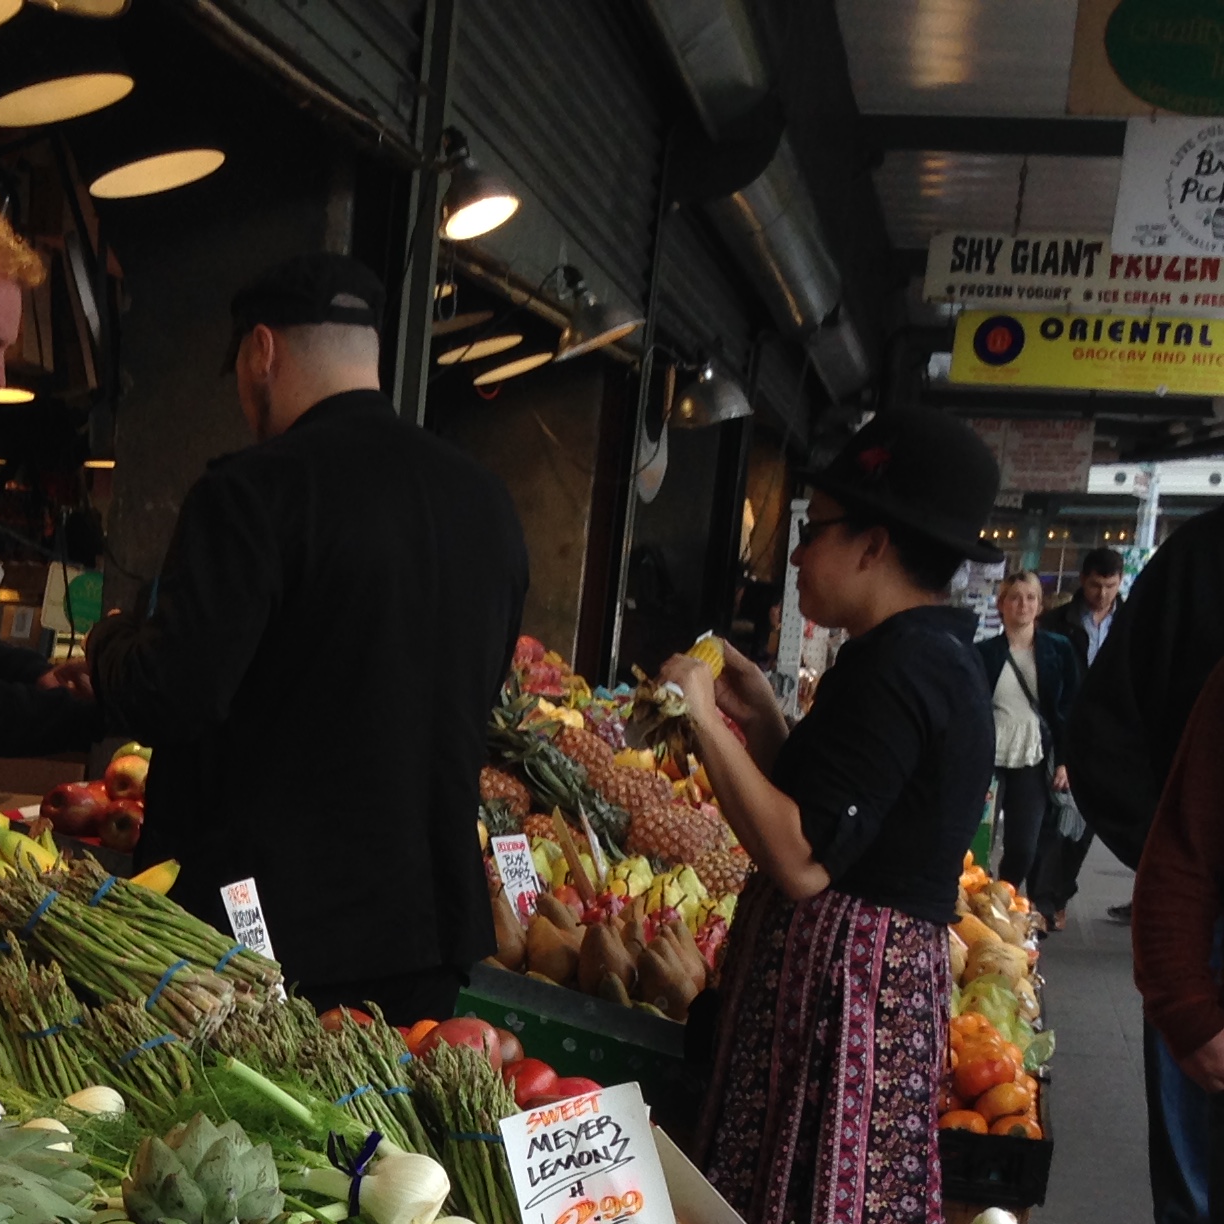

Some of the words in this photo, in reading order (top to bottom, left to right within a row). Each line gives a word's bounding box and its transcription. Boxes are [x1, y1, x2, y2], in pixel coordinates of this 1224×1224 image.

[950, 236, 1003, 274] SHY
[1010, 239, 1103, 278] GIANT
[960, 284, 1013, 299] FROZEN
[1017, 286, 1072, 300] YOGURT
[1097, 289, 1119, 304] ICE
[1123, 290, 1171, 305] CREAM
[1040, 317, 1213, 347] ORIENTAL
[1072, 347, 1147, 363] GROCERY
[1152, 350, 1186, 365] AND
[526, 1094, 602, 1134] SWEET
[527, 1115, 616, 1159] MEYER
[527, 1139, 630, 1187] LEMONS
